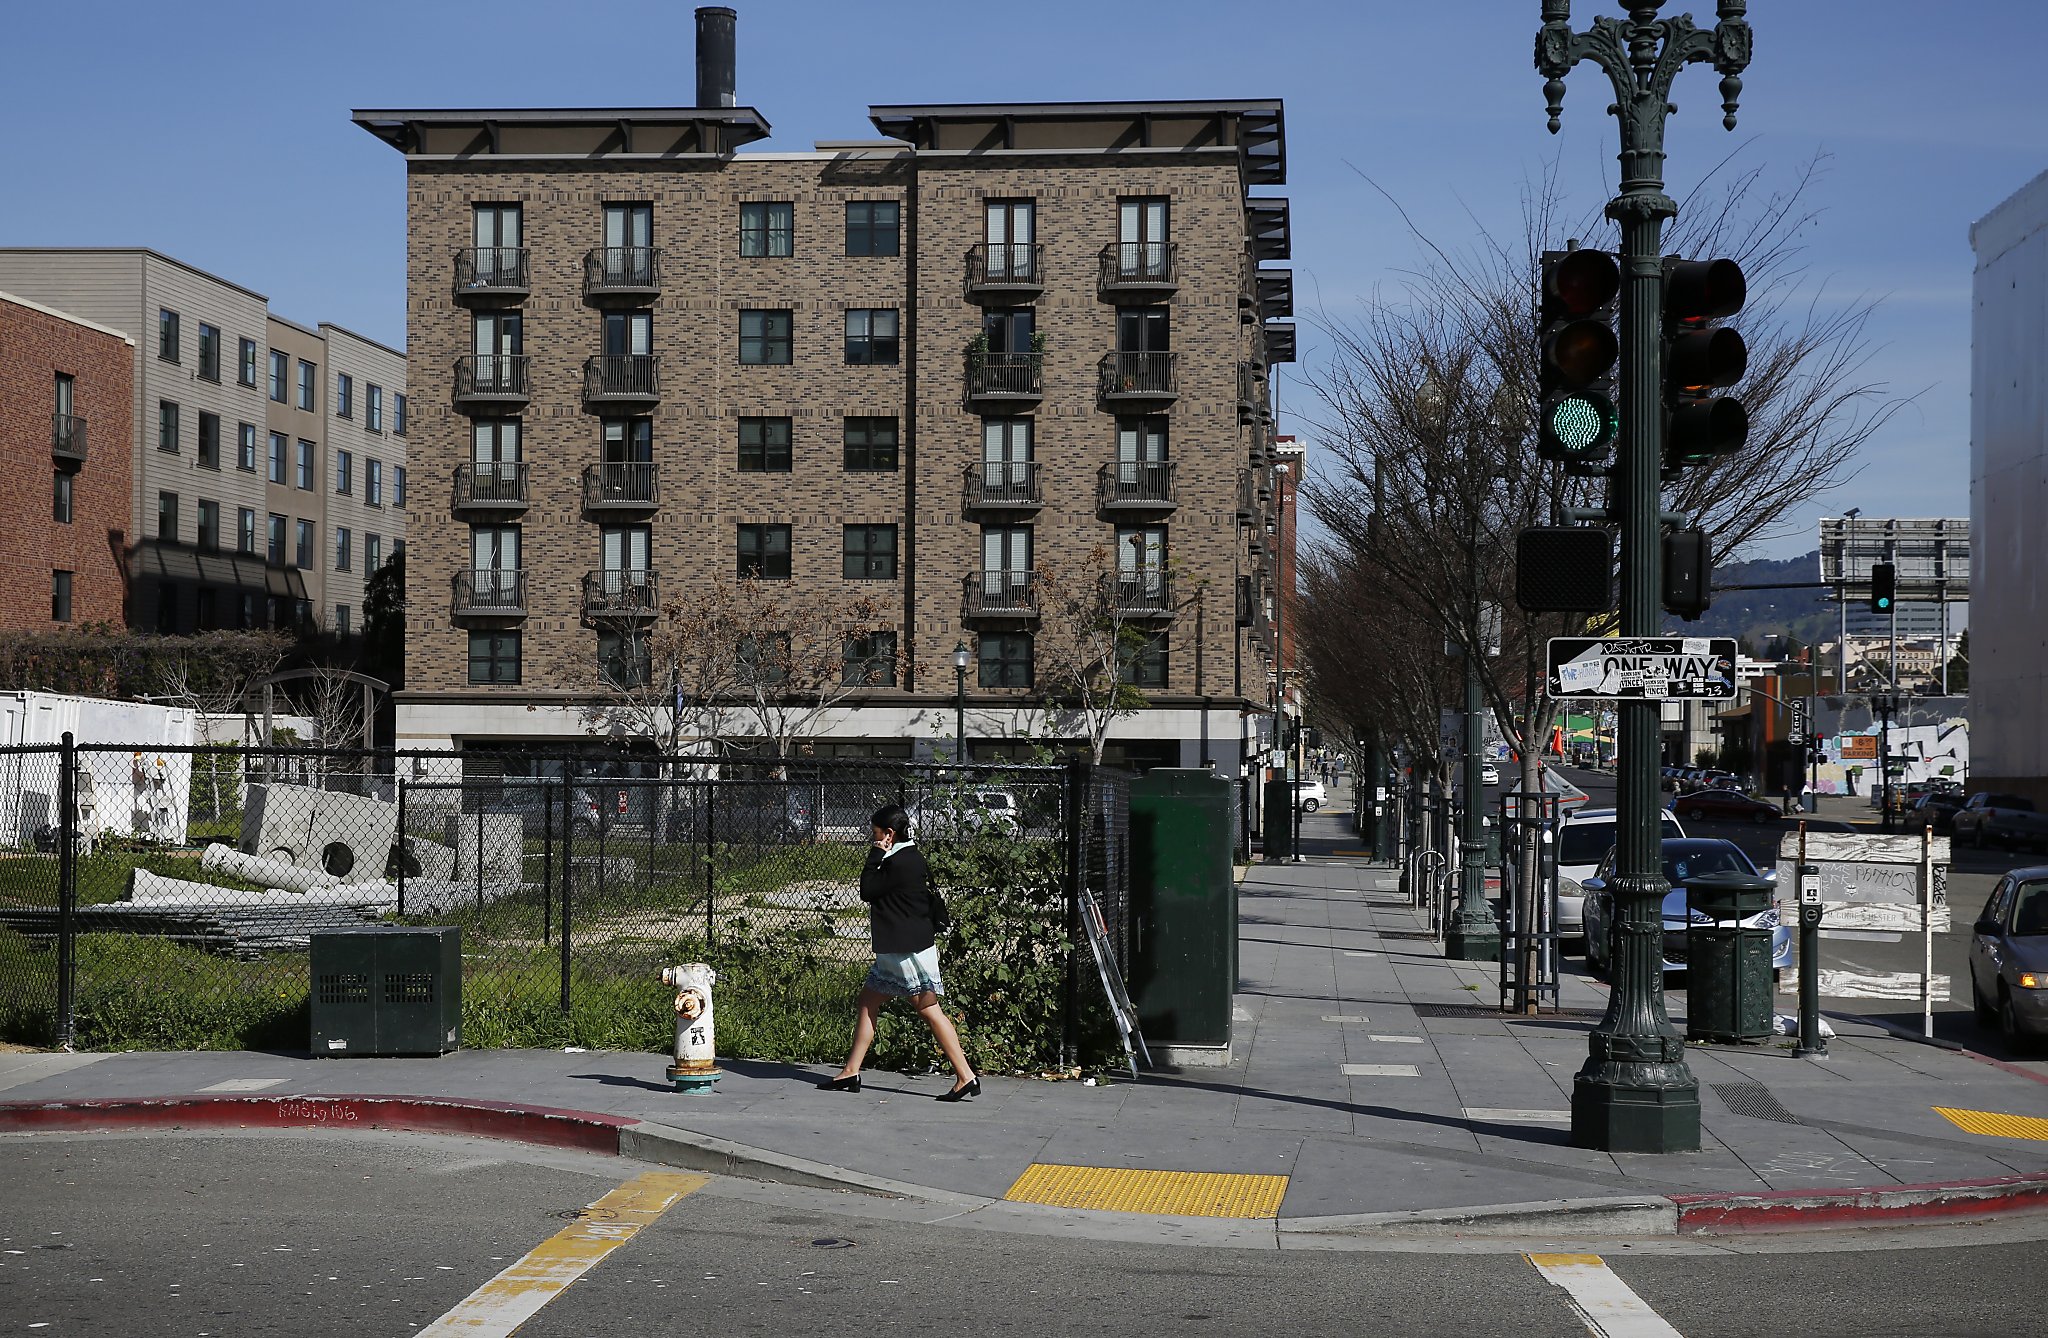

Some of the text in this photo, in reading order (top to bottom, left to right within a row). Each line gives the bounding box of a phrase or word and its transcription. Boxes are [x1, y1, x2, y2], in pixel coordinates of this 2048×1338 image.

[1663, 657, 1715, 679] WAY
[1620, 679, 1643, 687] VINCE?
[1645, 687, 1668, 695] VINCE?
